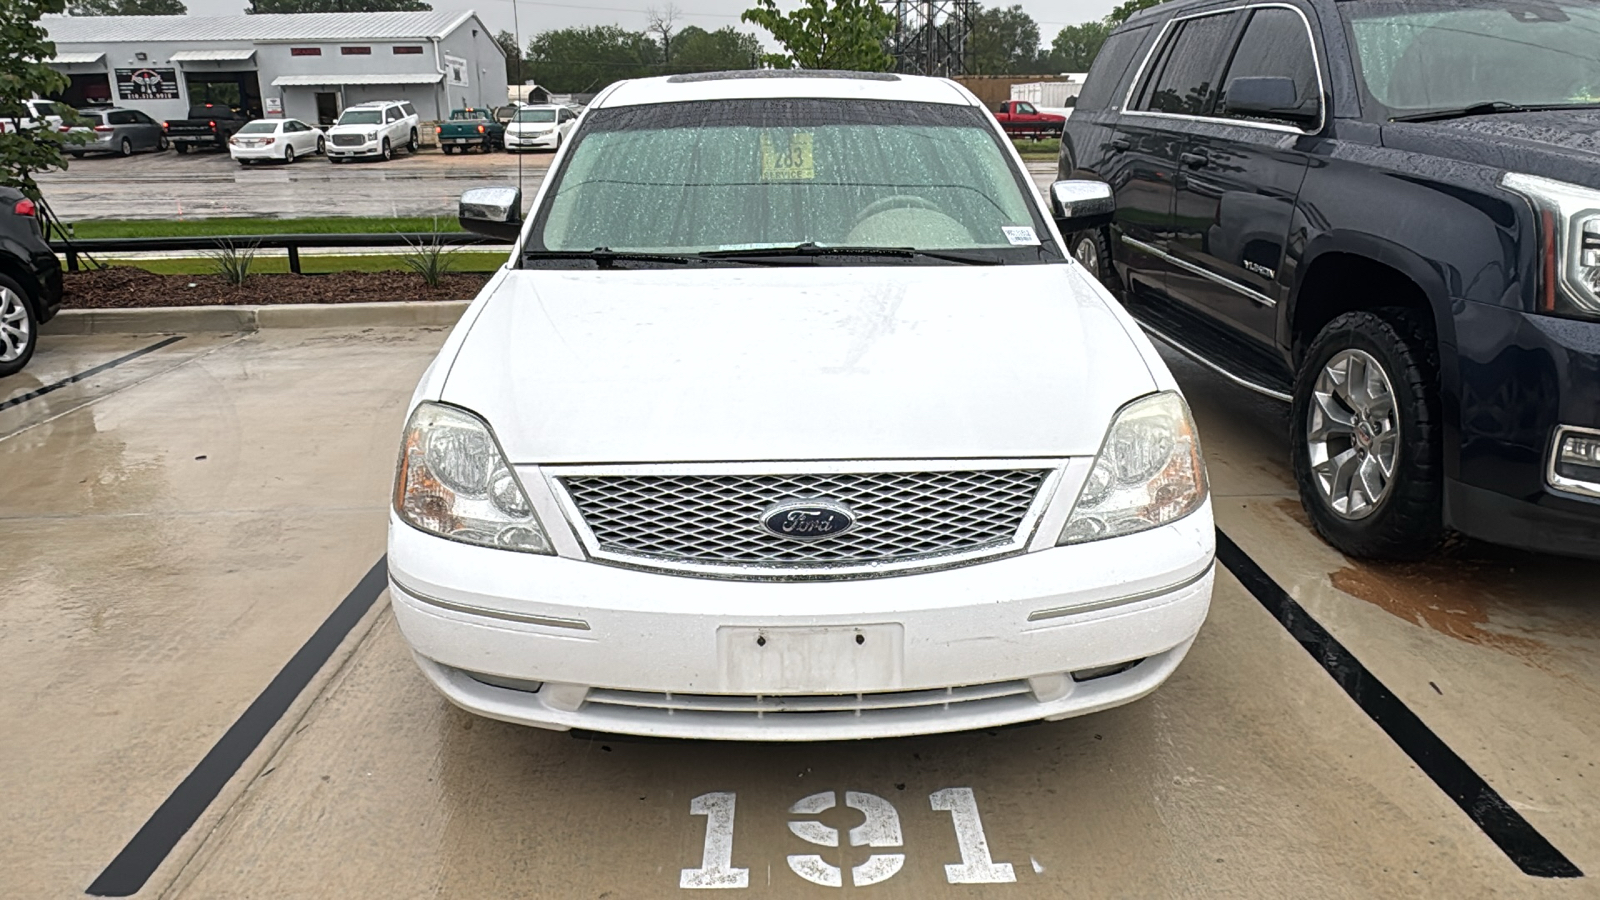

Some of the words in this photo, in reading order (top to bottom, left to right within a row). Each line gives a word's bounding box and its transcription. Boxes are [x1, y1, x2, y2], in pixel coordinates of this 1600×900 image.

[774, 147, 804, 168] 283
[782, 510, 834, 532] Ford
[679, 787, 1017, 889] 191
